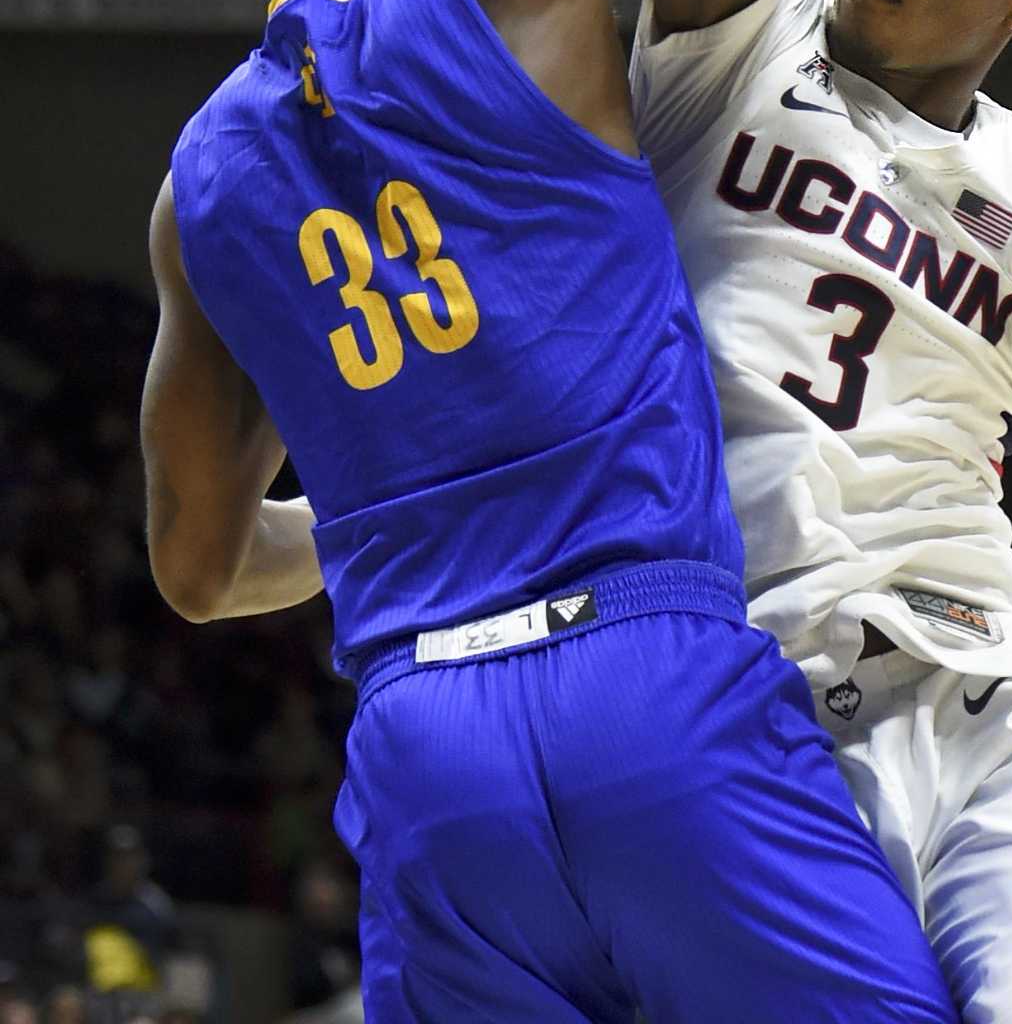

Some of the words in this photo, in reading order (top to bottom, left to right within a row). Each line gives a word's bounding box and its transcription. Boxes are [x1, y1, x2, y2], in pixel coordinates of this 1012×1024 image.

[298, 180, 479, 391] 33
[780, 273, 896, 431] 3
[465, 622, 504, 651] 33
[518, 614, 533, 631] L
